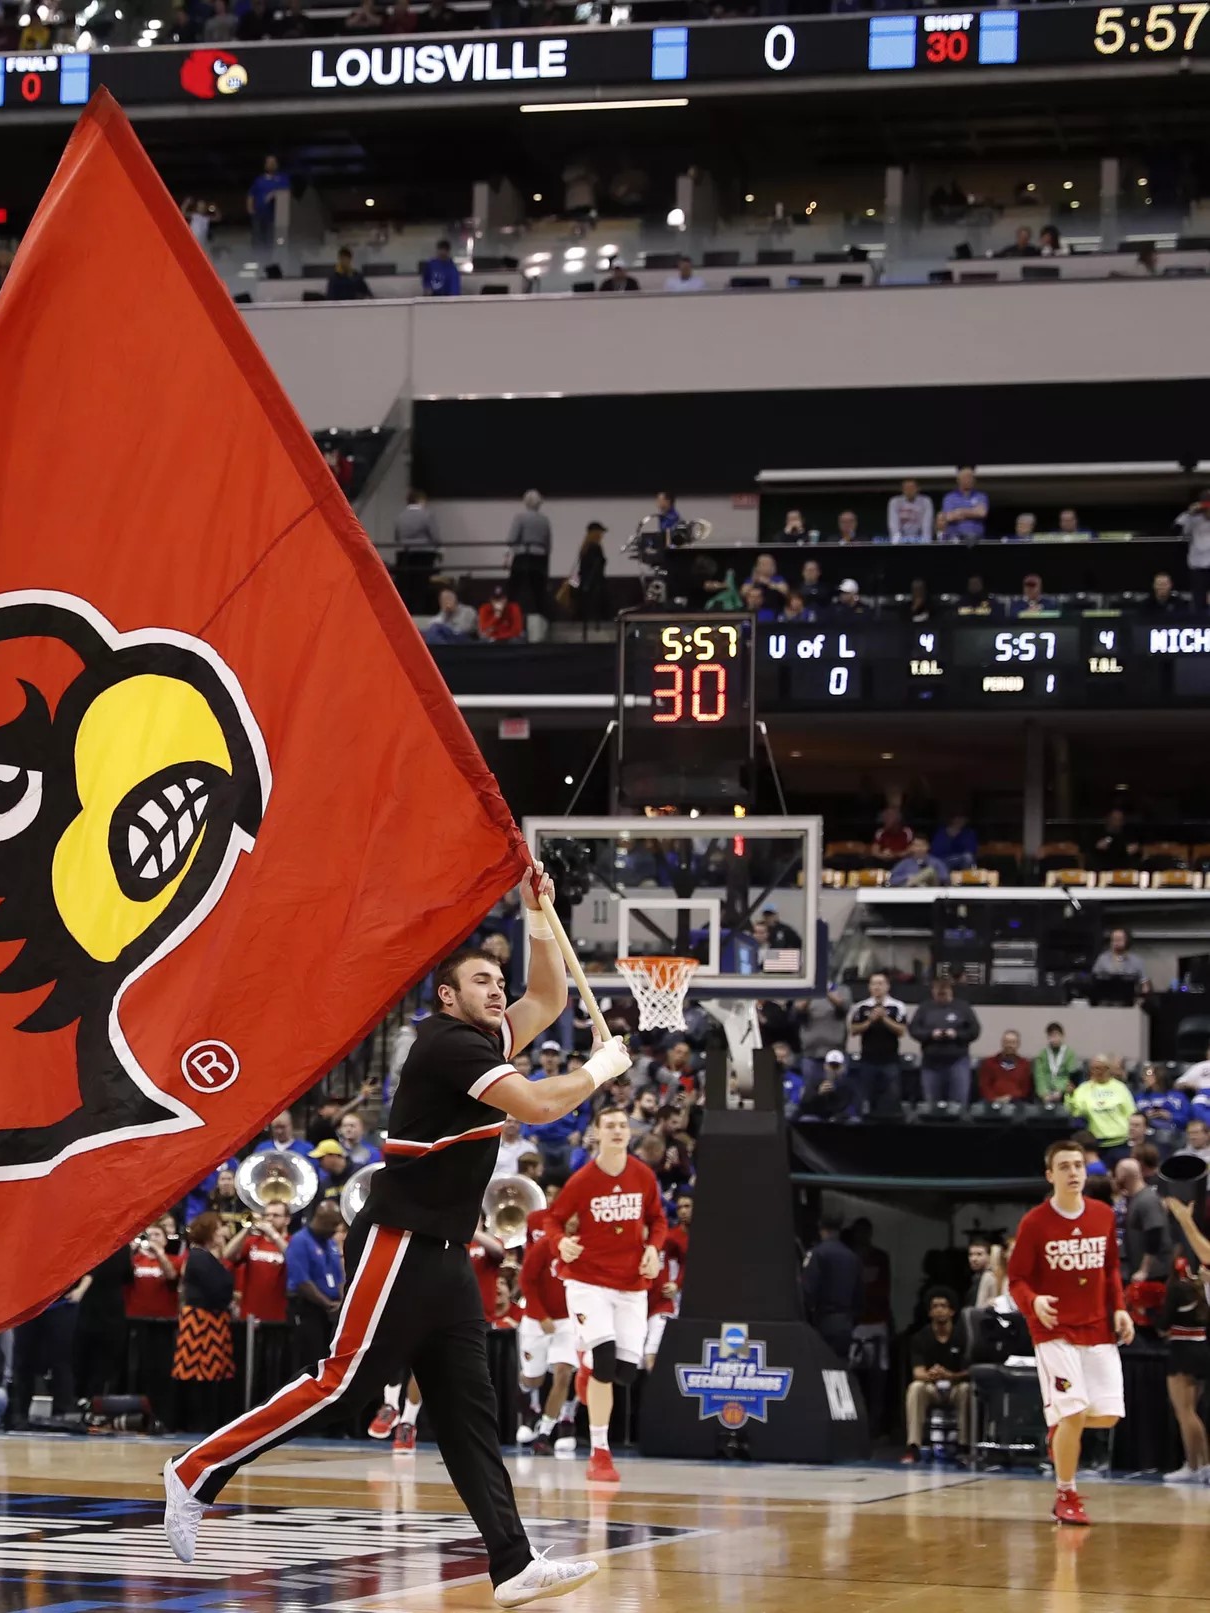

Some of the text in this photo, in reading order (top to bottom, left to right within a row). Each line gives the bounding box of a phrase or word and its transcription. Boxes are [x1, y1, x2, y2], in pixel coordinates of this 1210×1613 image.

[1093, 2, 1210, 55] 5:57
[764, 24, 795, 71] 0
[926, 31, 969, 63] 30
[311, 38, 568, 87] LOUISVILLE
[21, 72, 42, 102] 0
[661, 626, 737, 661] 5:57
[769, 634, 856, 659] U of L
[919, 633, 935, 653] 4
[995, 632, 1056, 661] 5:57
[1099, 630, 1115, 650] 4
[653, 663, 726, 722] 30
[828, 666, 849, 695] 0
[1046, 674, 1055, 693] 1
[590, 1193, 643, 1210] CREATE
[590, 1206, 642, 1222] YOURS
[1045, 1236, 1107, 1255] CREATE
[1044, 1250, 1105, 1271] YOURS
